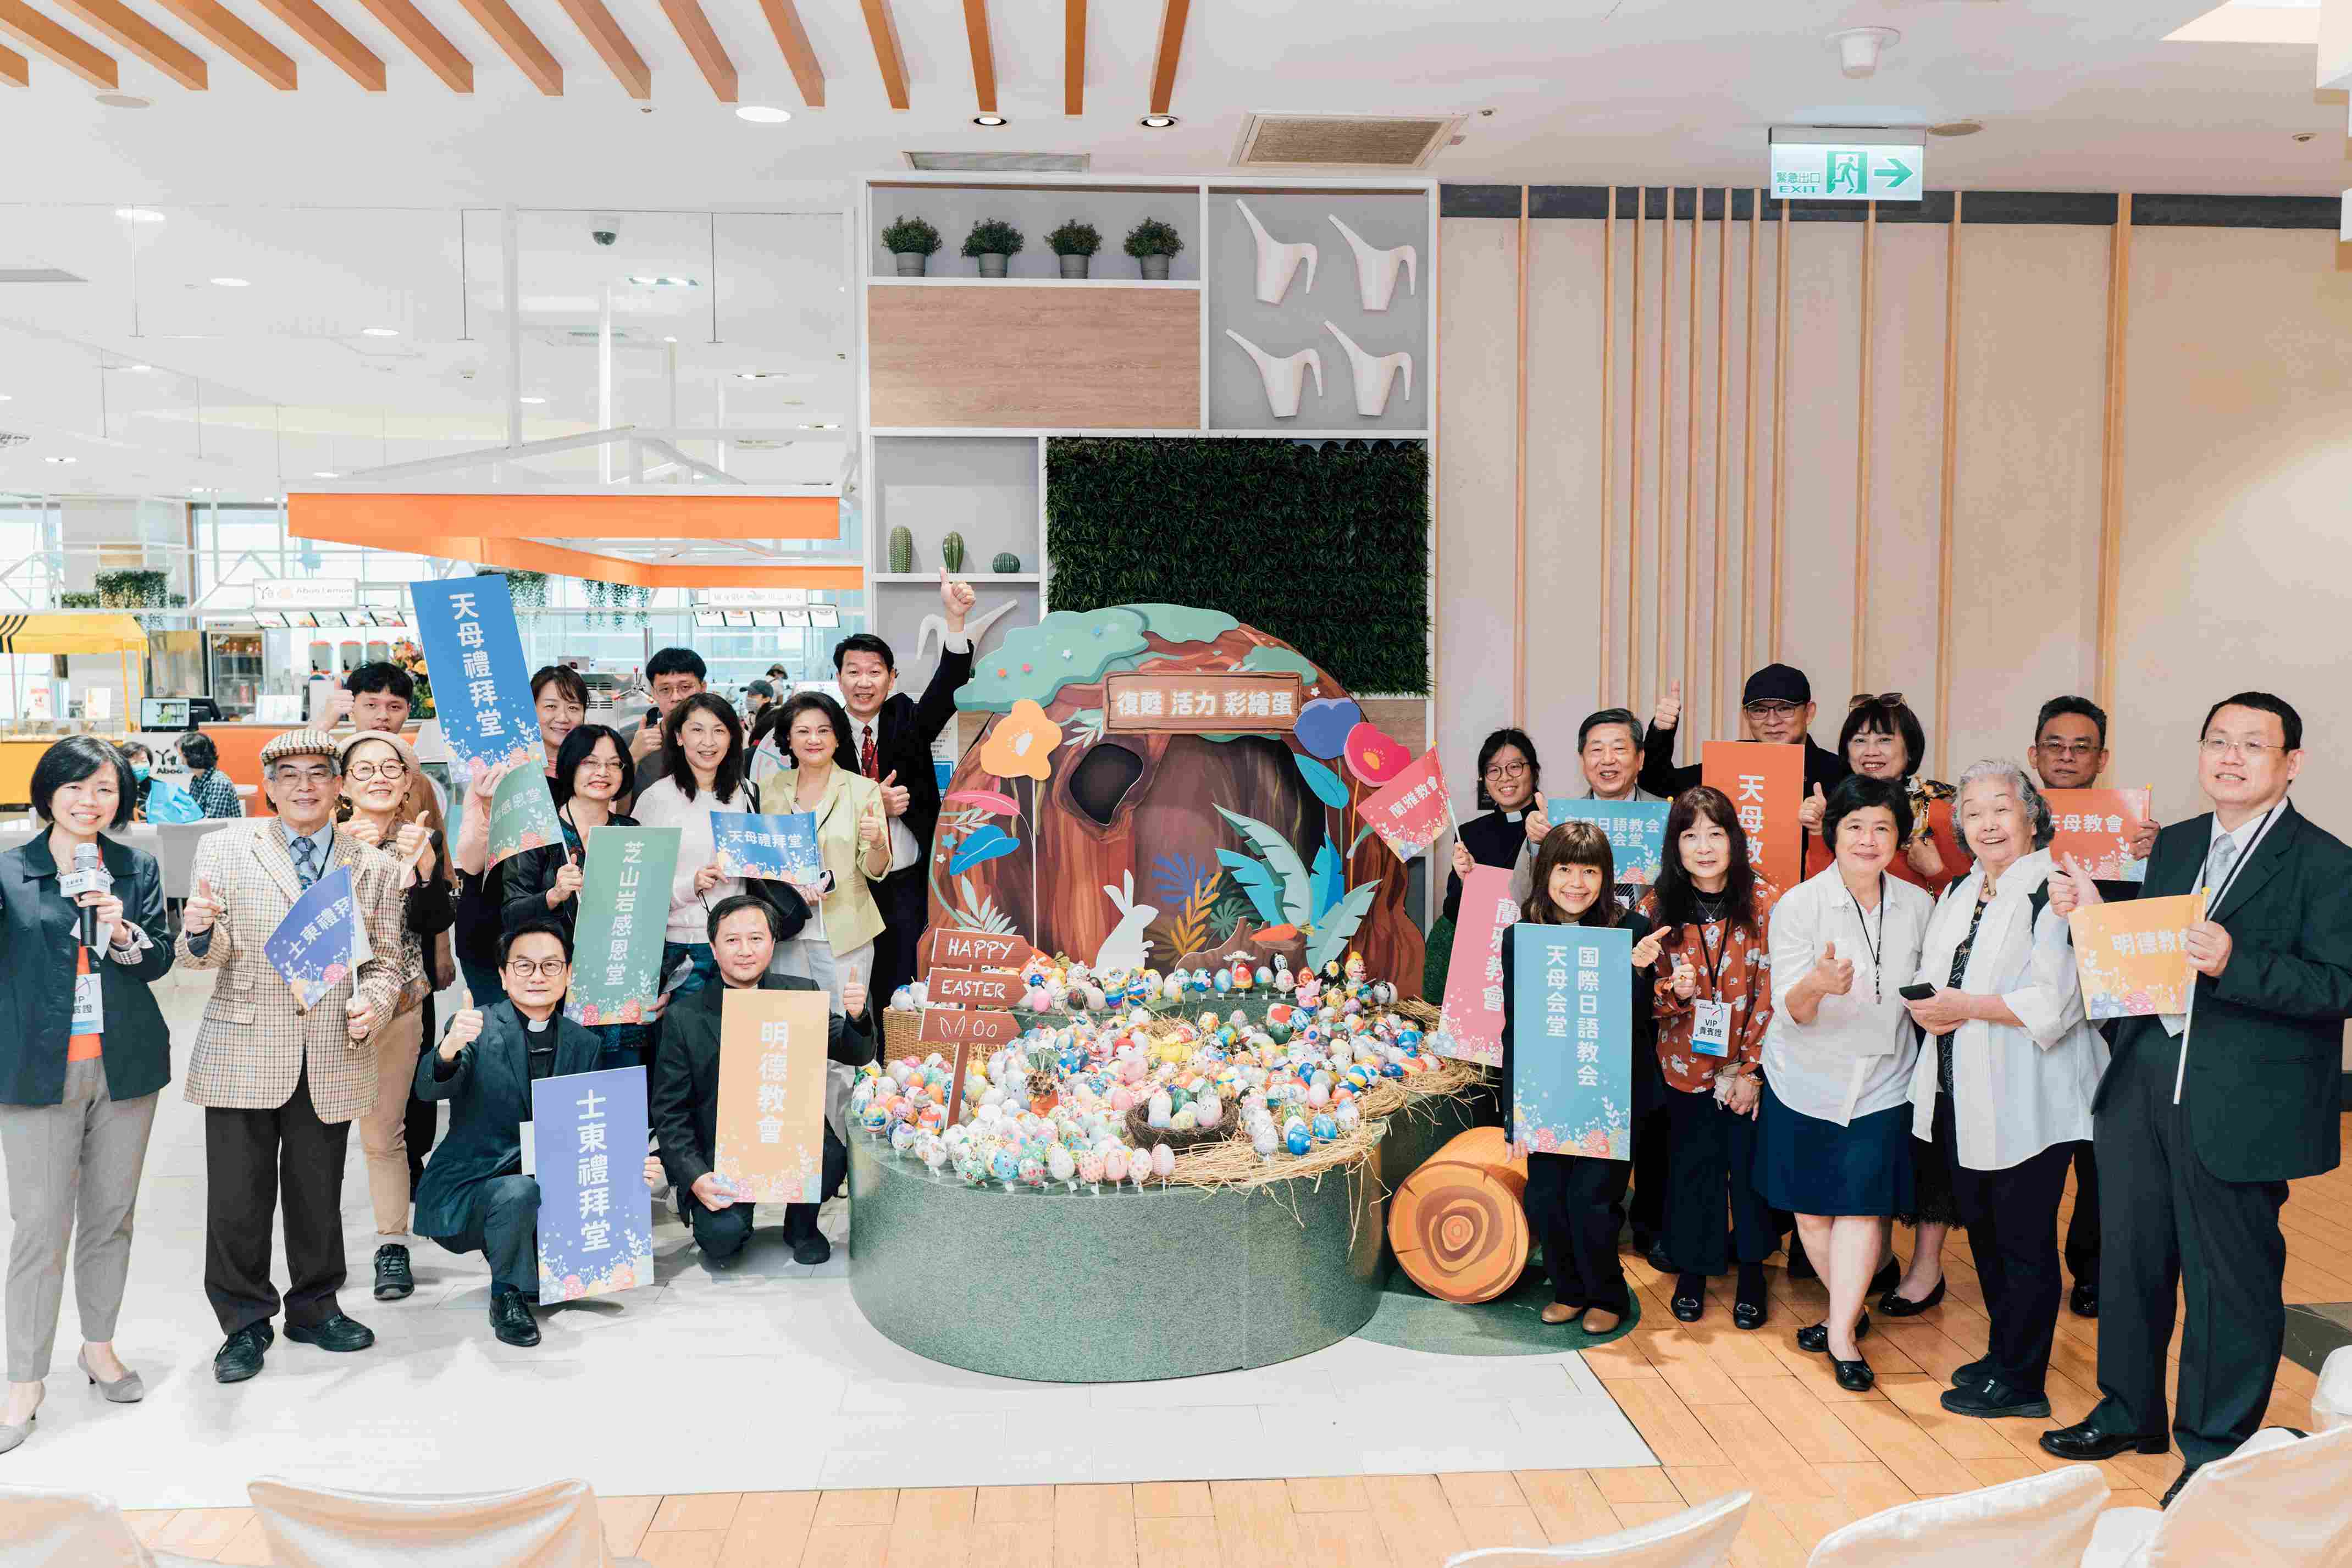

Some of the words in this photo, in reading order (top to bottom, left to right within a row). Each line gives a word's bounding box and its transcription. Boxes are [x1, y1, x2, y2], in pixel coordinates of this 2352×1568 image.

[1776, 171, 1820, 184] 緊急出口
[1778, 185, 1818, 193] EXIT
[449, 593, 505, 738] 天母禮拜堂
[1170, 689, 1218, 716] 活力
[1224, 689, 1293, 716] 彩繪蛋
[1565, 816, 1660, 833] 日語教会
[728, 830, 803, 848] 天母禮拜堂
[604, 840, 645, 985] 芝山岩感恩堂
[948, 938, 1015, 960] HAPPY
[941, 978, 1005, 999] EASTER
[1546, 945, 1568, 1038] 天母会堂
[1576, 946, 1599, 1087] 国際日語教会
[1705, 1018, 1718, 1027] VIP
[757, 1020, 788, 1144] 明德教會
[576, 1089, 611, 1253] 士東禮拜堂
